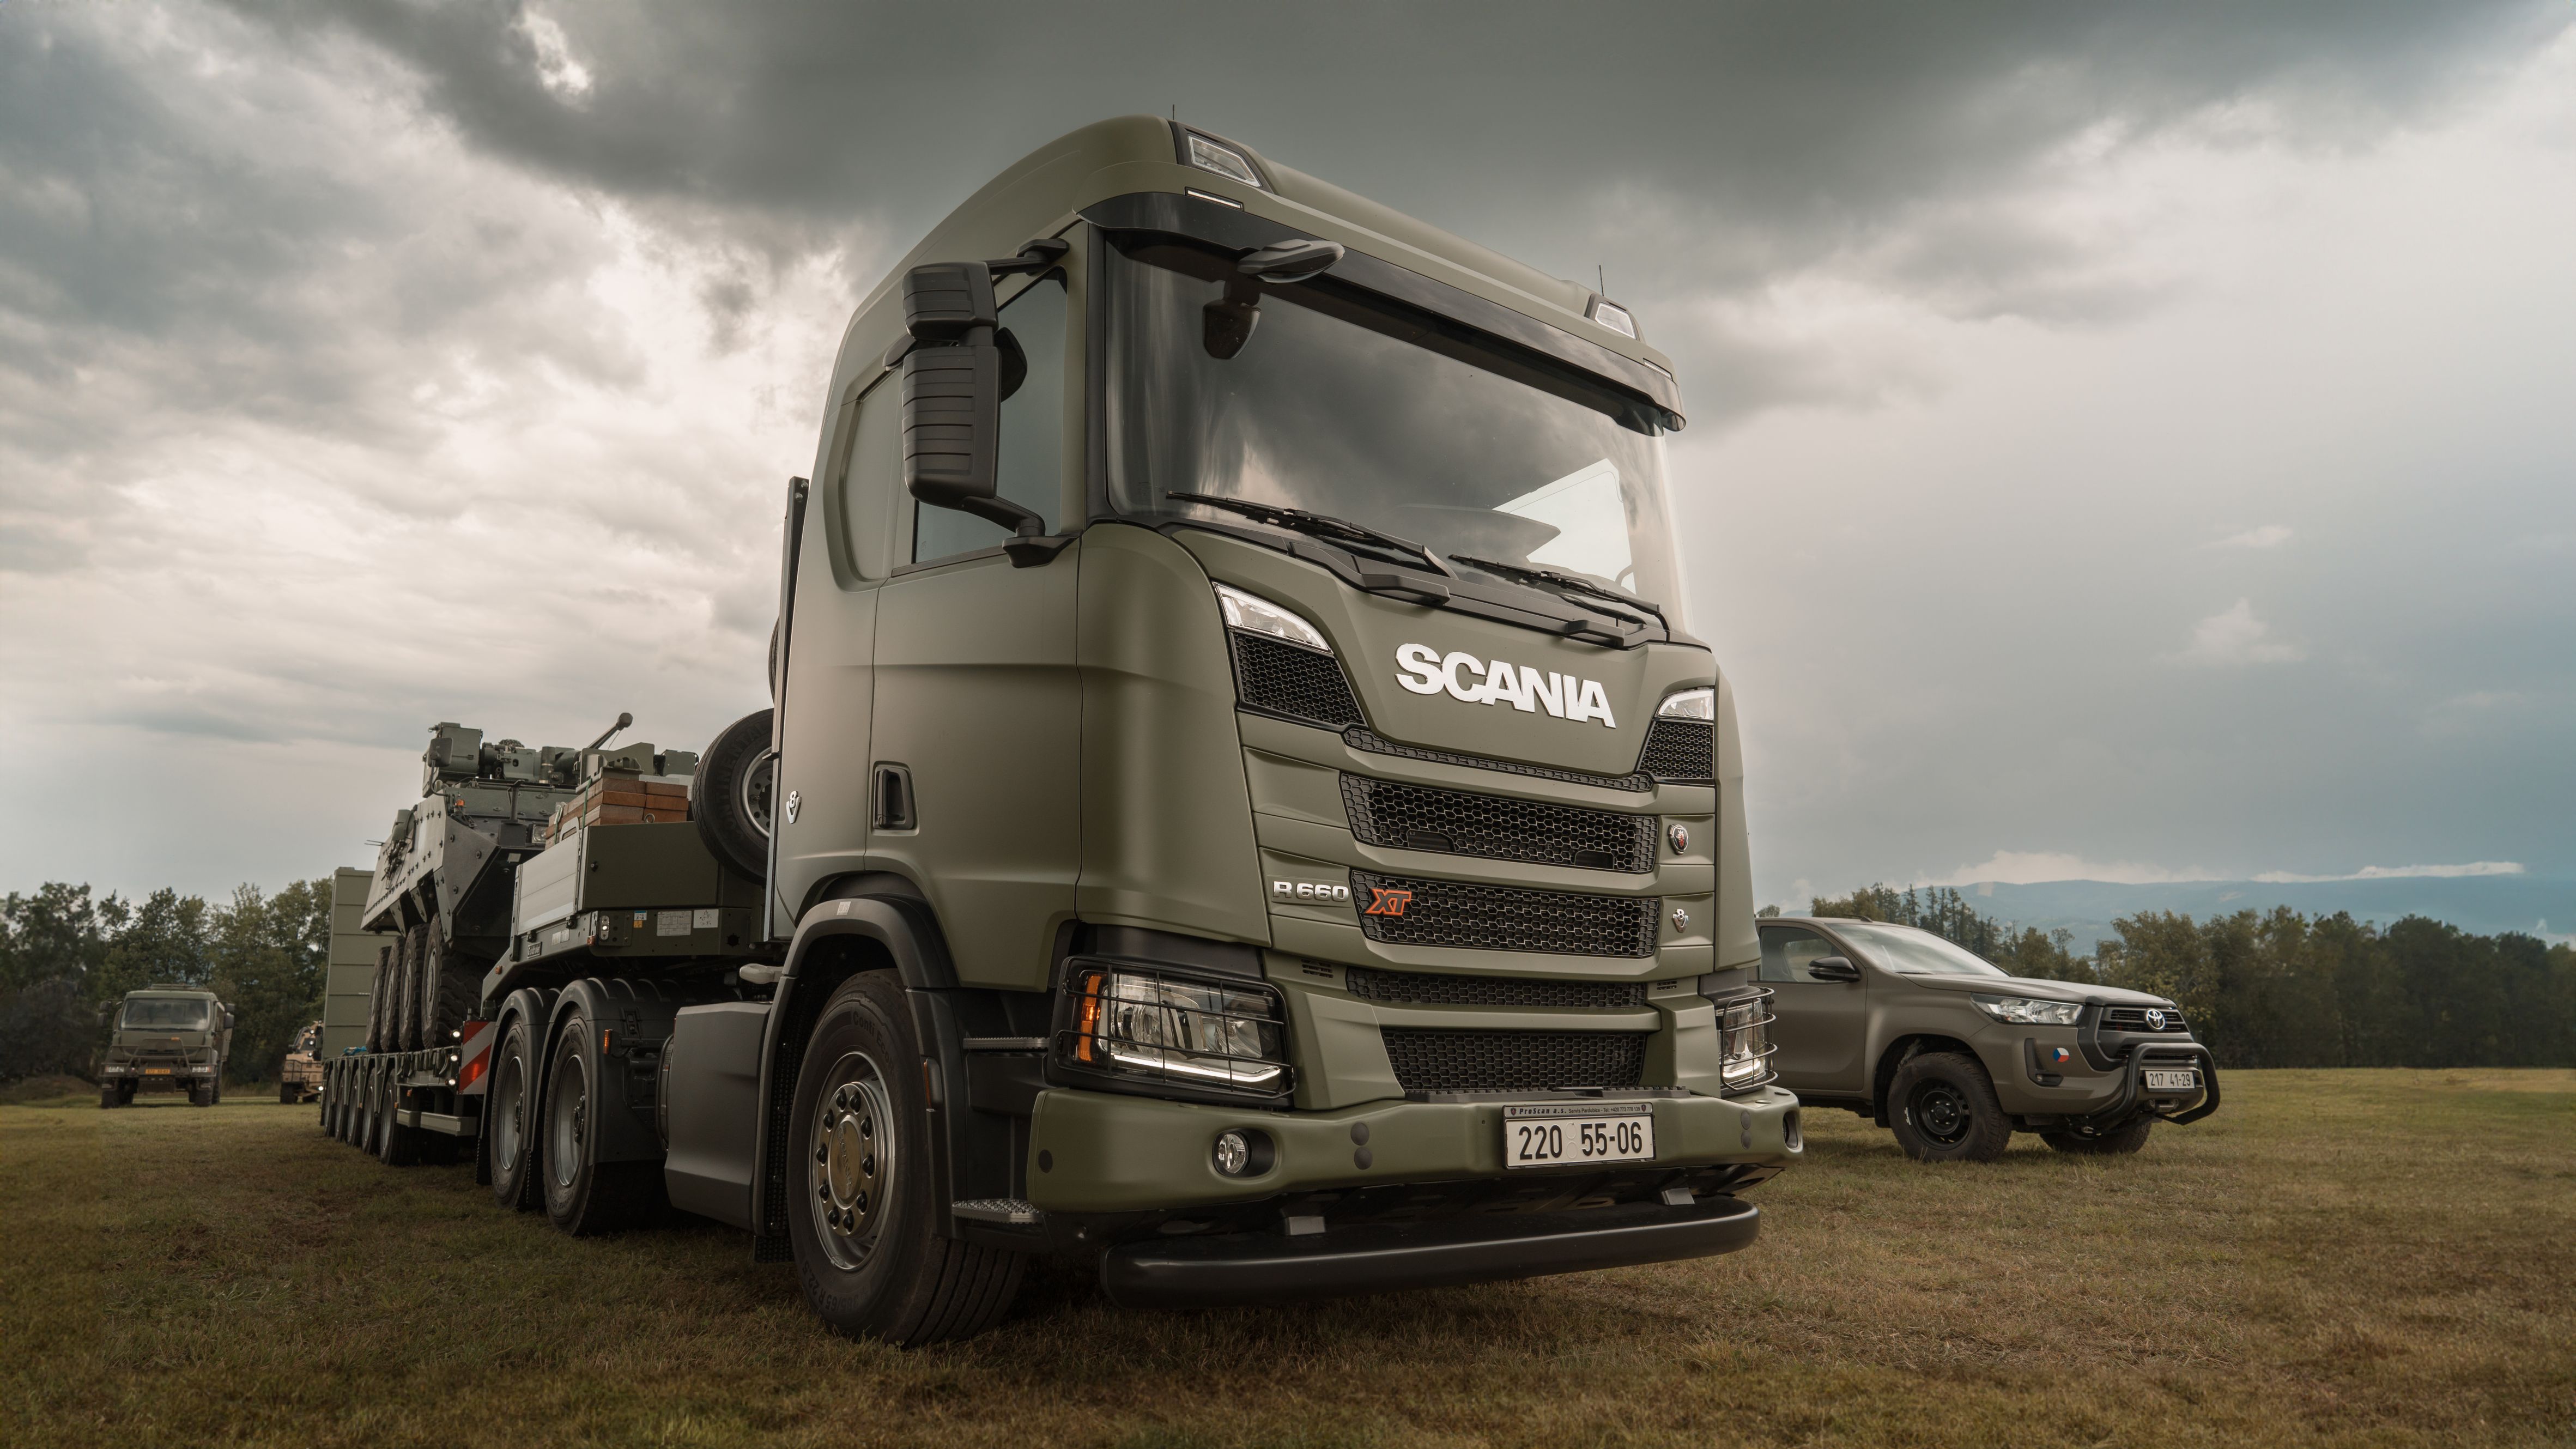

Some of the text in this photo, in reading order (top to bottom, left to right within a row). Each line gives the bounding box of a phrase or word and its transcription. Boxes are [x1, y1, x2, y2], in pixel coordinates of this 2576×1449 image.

[1395, 643, 1616, 729] SCANIA
[1273, 881, 1349, 902] R 660
[1365, 889, 1412, 917] XT
[853, 1011, 875, 1036] Conti
[2149, 1073, 2191, 1086] 217 41-29
[1518, 1121, 1642, 1160] 220 55-06
[802, 1260, 820, 1296] 22.5
[818, 1287, 826, 1305] R
